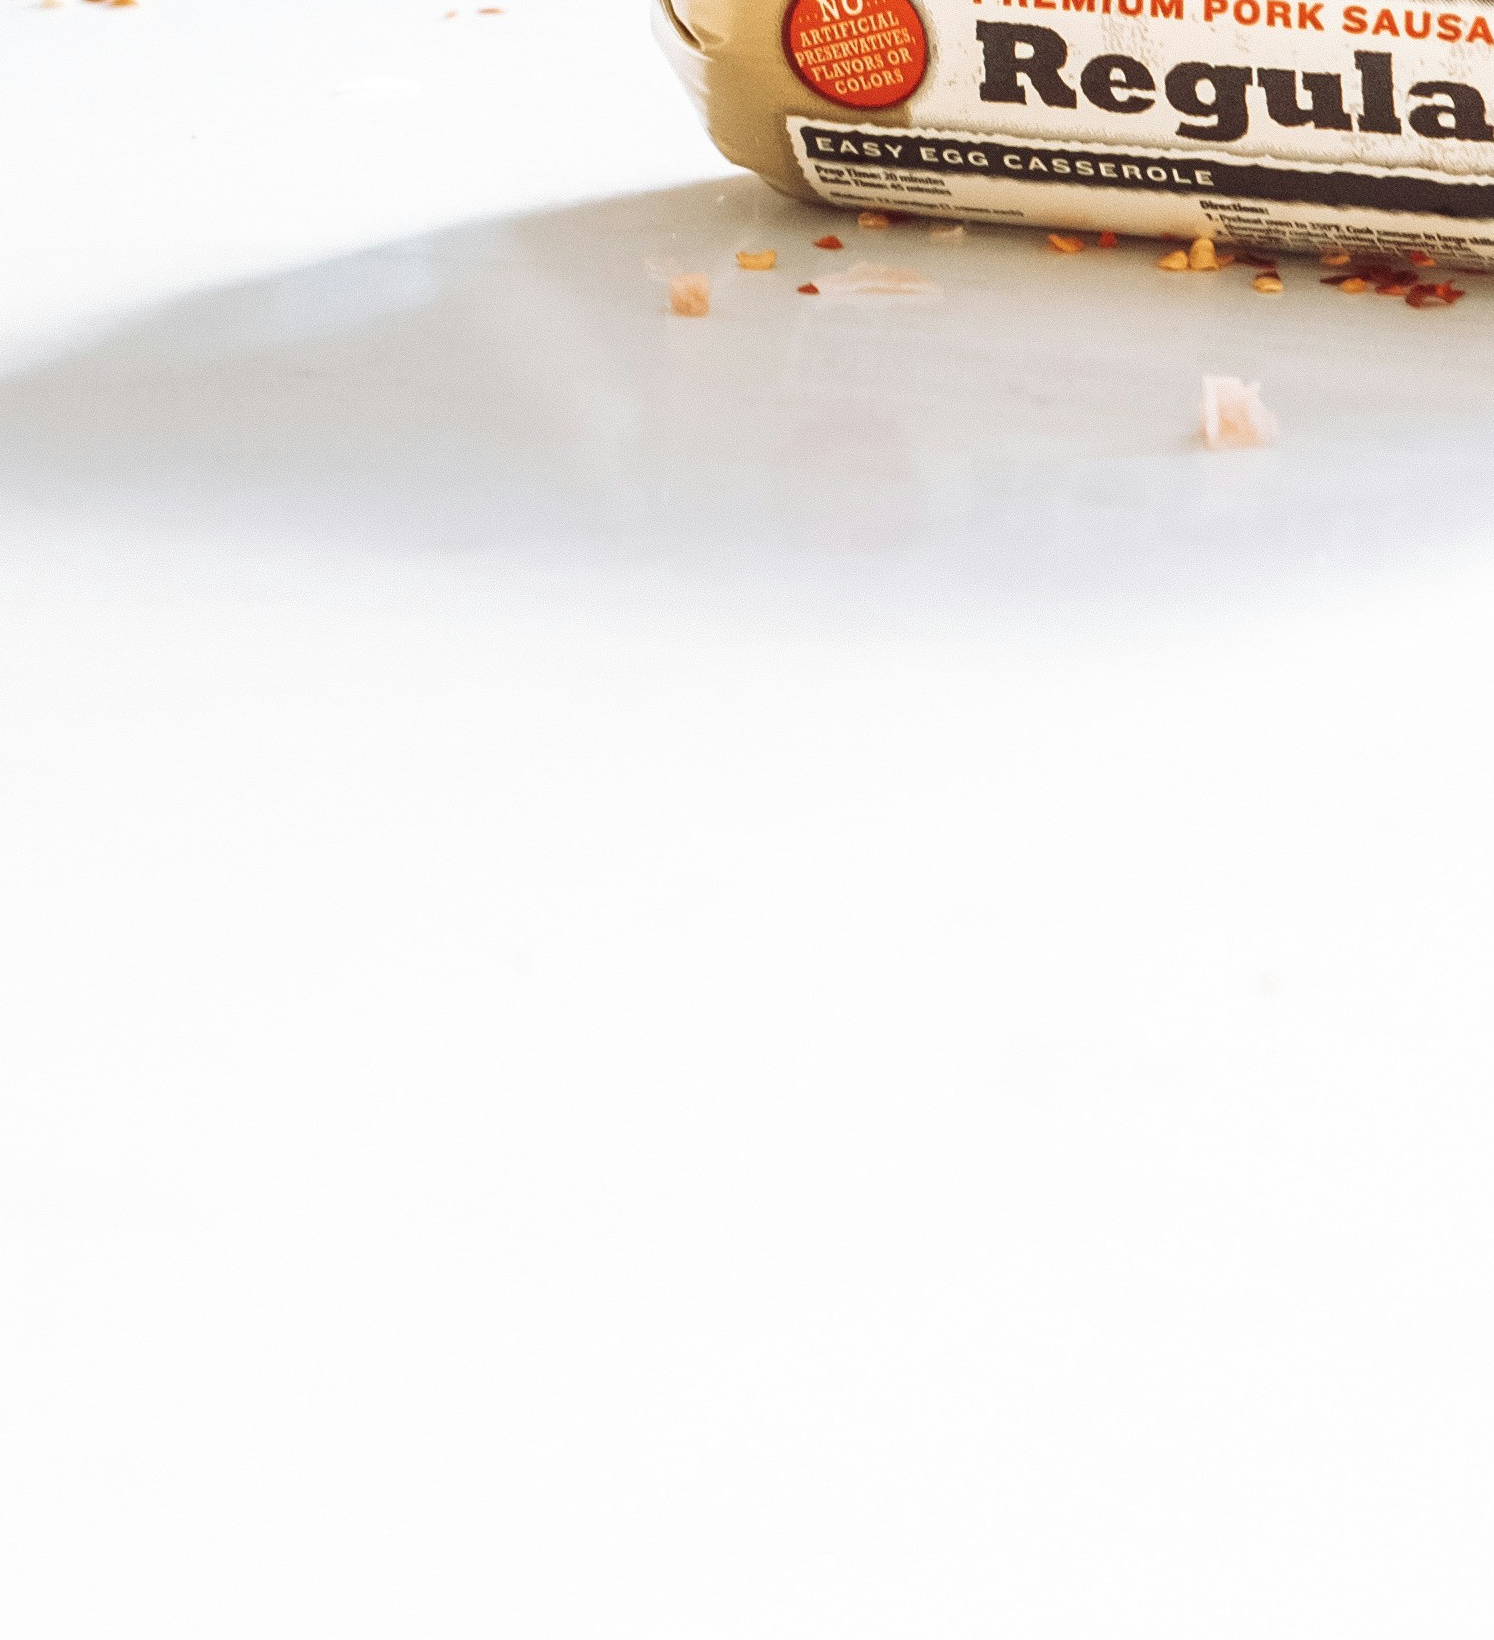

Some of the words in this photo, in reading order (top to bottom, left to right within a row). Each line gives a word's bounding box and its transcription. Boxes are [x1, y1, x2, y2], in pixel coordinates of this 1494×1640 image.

[794, 27, 917, 68] PRESERVATIVES,
[799, 10, 900, 48] ARTIFICIAL
[810, 53, 885, 82] FLAVORS
[886, 46, 913, 65] OR
[834, 67, 904, 95] COLORS
[814, 136, 904, 159] EASY
[918, 146, 991, 168] EGG
[1003, 153, 1215, 187] CASSEROLE
[1199, 199, 1271, 216] Directions:
